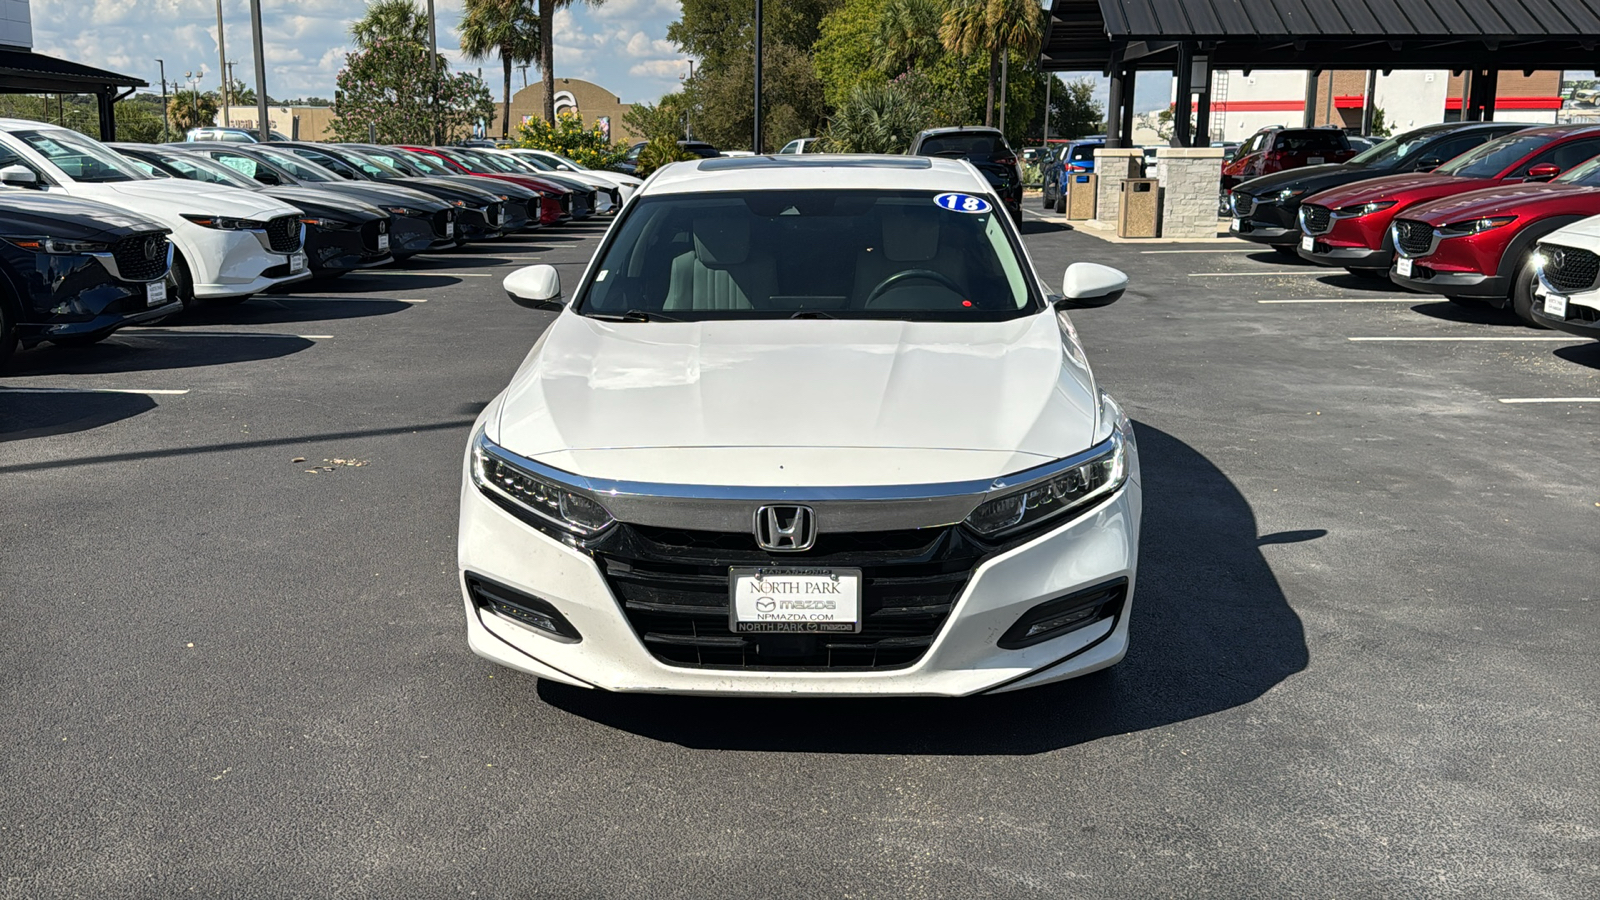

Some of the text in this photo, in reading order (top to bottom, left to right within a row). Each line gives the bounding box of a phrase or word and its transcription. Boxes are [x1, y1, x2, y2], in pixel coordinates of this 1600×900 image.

[946, 195, 979, 210] 18
[750, 581, 841, 594] NORTH PARK
[780, 600, 836, 610] mazda
[757, 613, 834, 621] NPMAZDA.COM
[738, 623, 774, 631] NORTH
[777, 623, 804, 631] PARK
